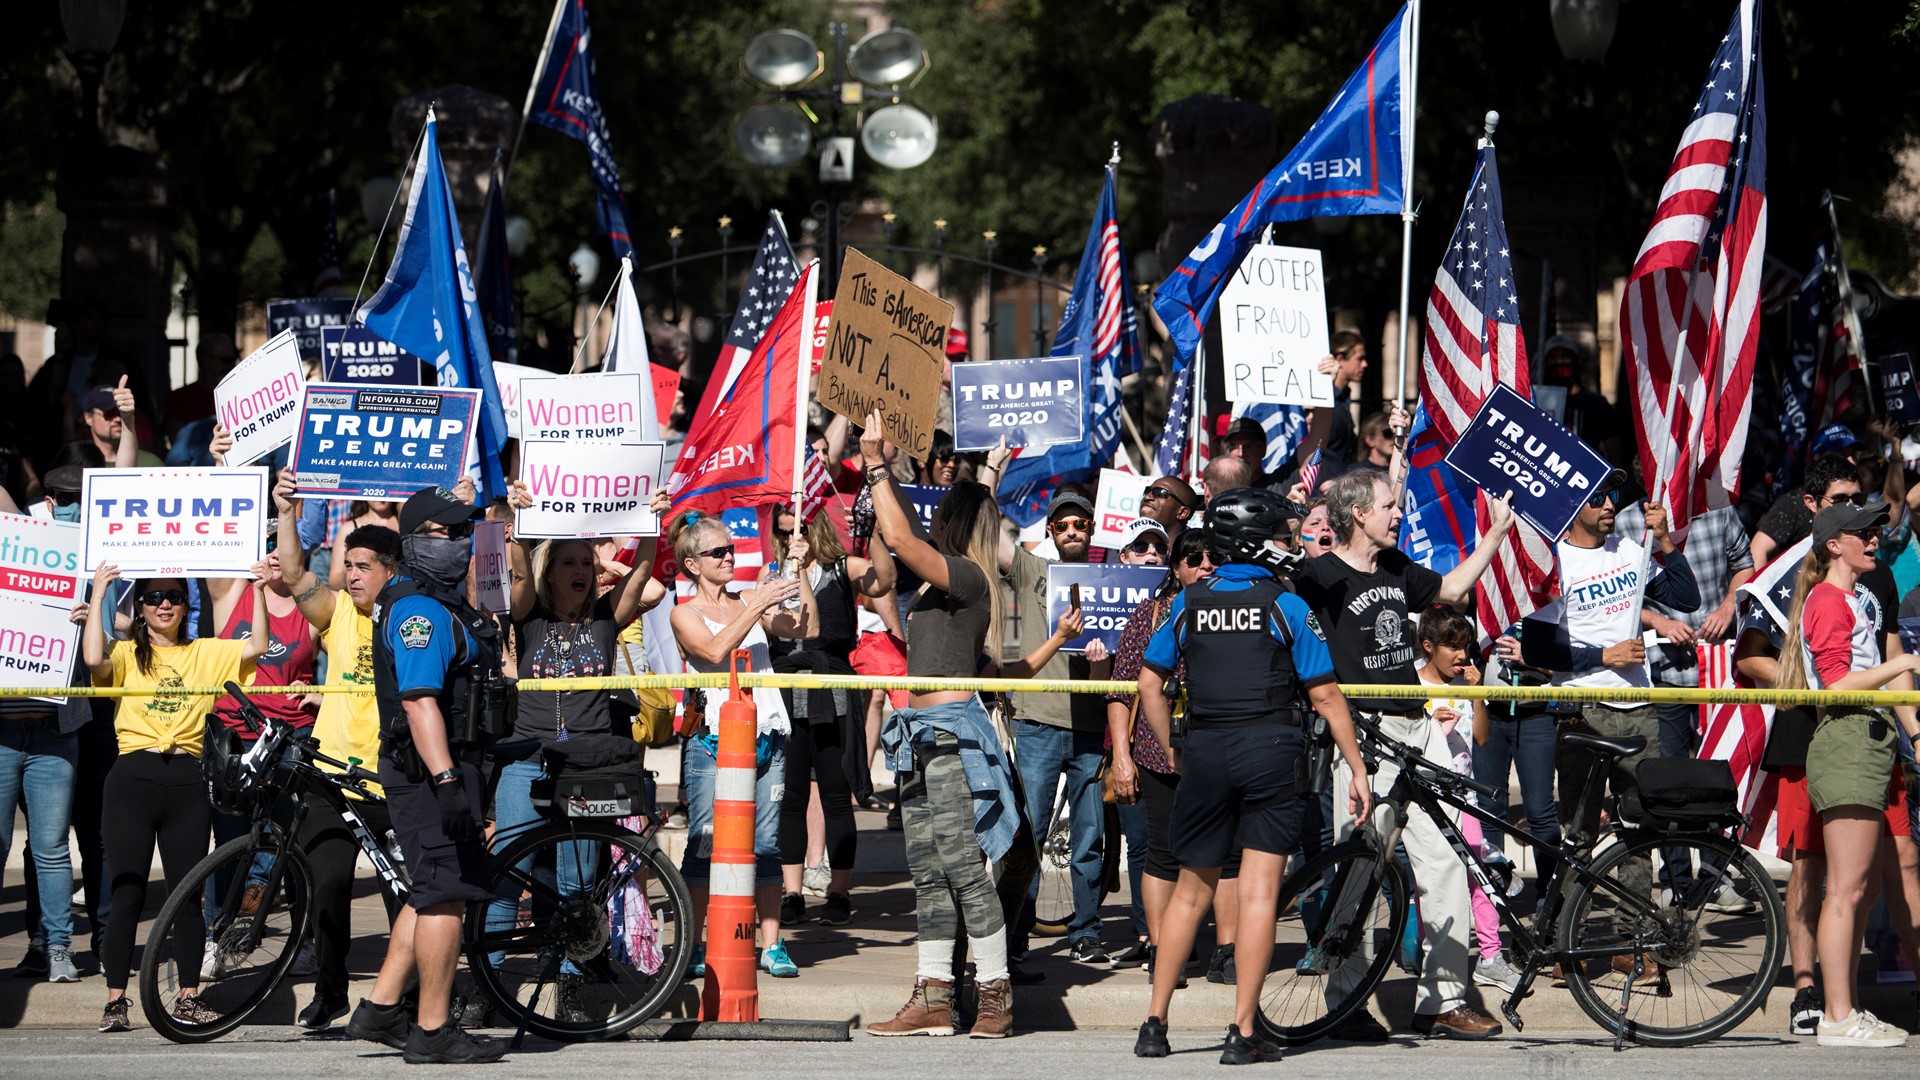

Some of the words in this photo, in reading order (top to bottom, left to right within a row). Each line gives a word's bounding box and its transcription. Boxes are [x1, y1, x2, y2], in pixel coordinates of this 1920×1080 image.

[1239, 257, 1318, 292] VOTER
[852, 272, 877, 307] This
[883, 290, 894, 316] is
[1236, 304, 1310, 338] FRAUD
[326, 341, 406, 357] TRUM
[829, 320, 872, 374] NOT
[1271, 348, 1286, 365] is
[346, 364, 394, 378] 2020
[960, 379, 1075, 402] TRUMP
[1234, 363, 1328, 401] REAL
[221, 371, 299, 432] Women
[361, 395, 437, 406] INFOWARS.COM
[235, 422, 257, 442] FOR
[259, 400, 296, 428] TRUMP
[527, 398, 633, 426] Women
[988, 410, 1049, 428] 2020
[309, 414, 464, 440] TRUMP
[540, 430, 570, 439] FOR
[576, 427, 625, 439] TRUMP
[318, 440, 446, 458] PENCE
[1487, 408, 1590, 490] TRUMP
[311, 458, 336, 466] MAKE
[415, 463, 447, 471] AGAIN!
[1494, 437, 1511, 450] KEEP
[1511, 449, 1538, 471] AMERICA
[1538, 469, 1560, 489] GREAT!
[530, 464, 652, 498] Women
[1488, 451, 1547, 498] 2020
[362, 488, 385, 496] 2020
[95, 498, 255, 518] TRUMP
[541, 500, 576, 513] FOR
[582, 500, 638, 513] TRUMP
[1215, 505, 1243, 513] POLICE
[108, 522, 238, 535] PENCE
[1106, 516, 1128, 530] FO
[1129, 519, 1163, 530] TRUMP
[580, 528, 596, 537] 2020
[7, 572, 71, 593] TRUMP
[1573, 571, 1638, 604] TRUMP
[1056, 586, 1152, 604] TRUM
[1577, 602, 1597, 611] KEEP
[1599, 593, 1628, 607] AMERICA
[1605, 600, 1630, 615] 2020
[401, 616, 432, 630] POLICE
[1083, 615, 1130, 631] 202
[1197, 608, 1261, 632] POLICE
[1363, 654, 1390, 669] RESIST
[582, 803, 616, 815] POLICE
[341, 811, 409, 896] TREK
